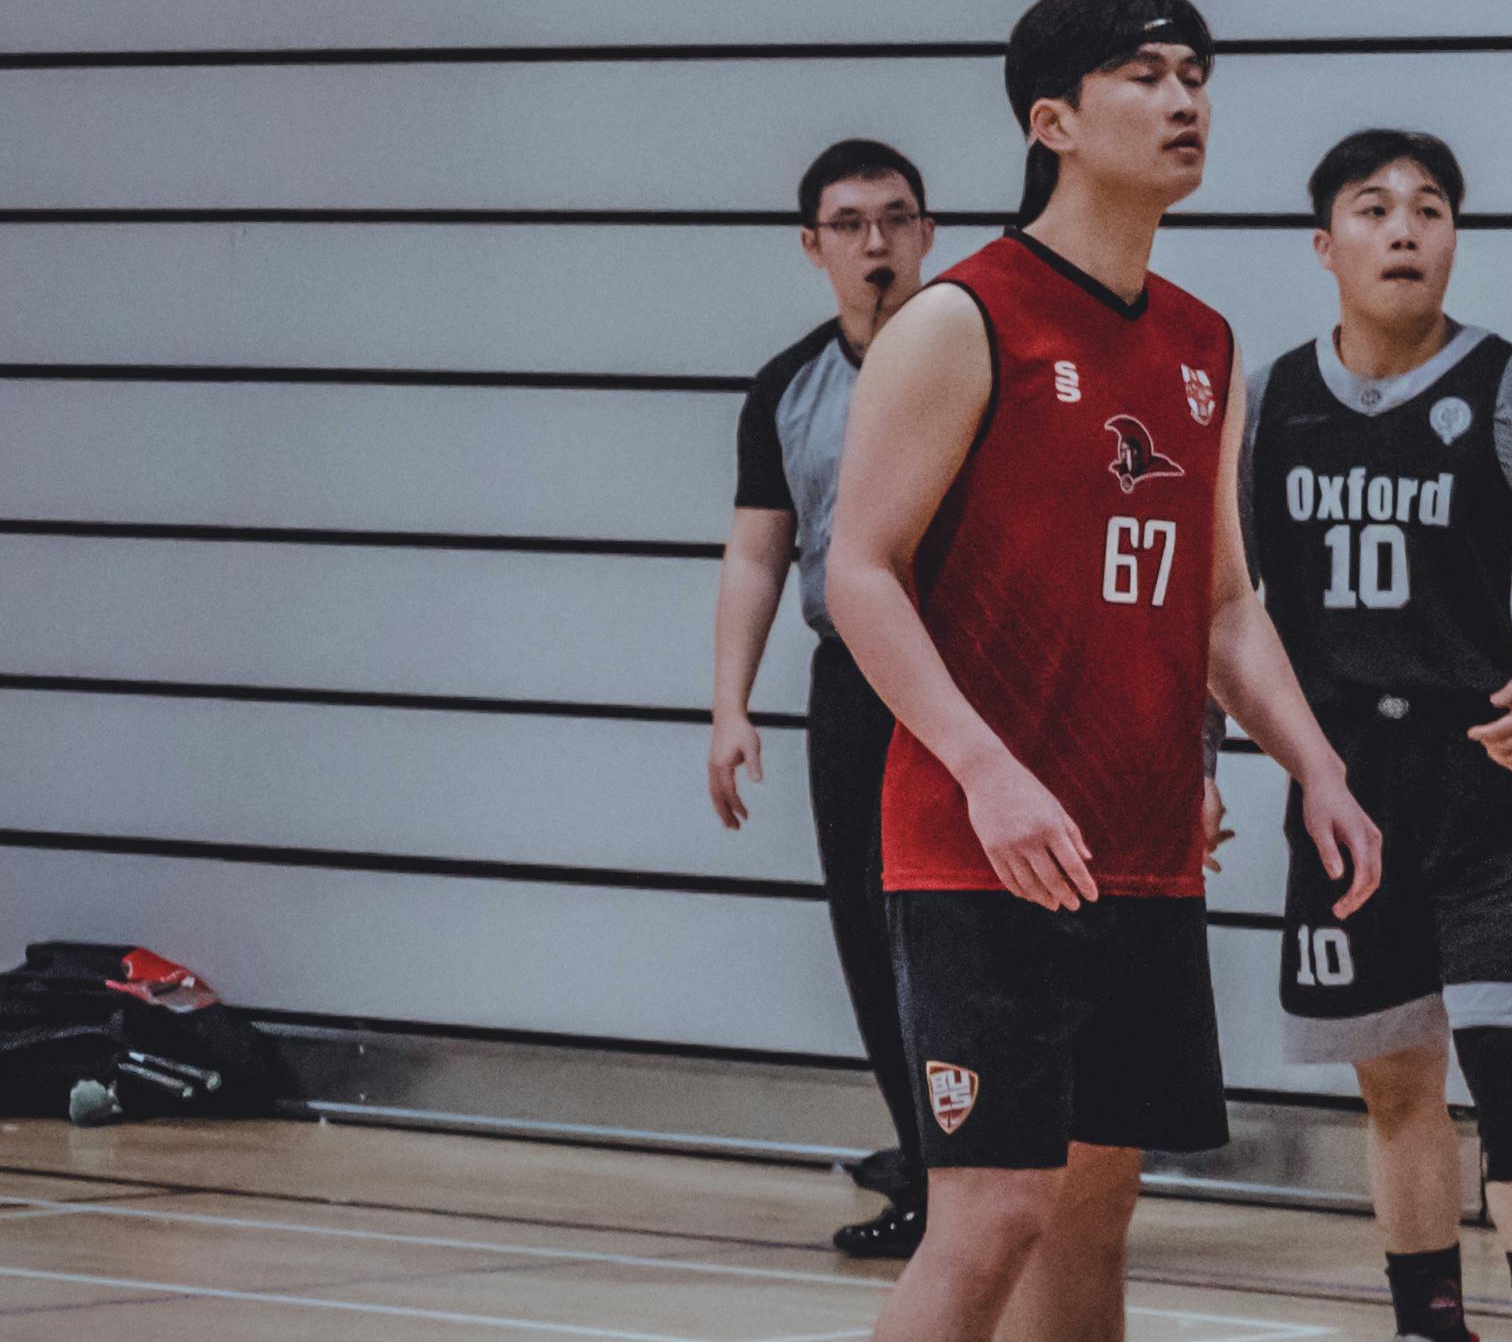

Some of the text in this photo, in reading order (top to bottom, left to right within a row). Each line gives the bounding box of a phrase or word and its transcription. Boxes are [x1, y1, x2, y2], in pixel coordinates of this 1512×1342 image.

[1286, 465, 1454, 527] Oxford
[1102, 516, 1176, 606] 67
[1323, 523, 1410, 610] 10
[1296, 923, 1354, 986] 10
